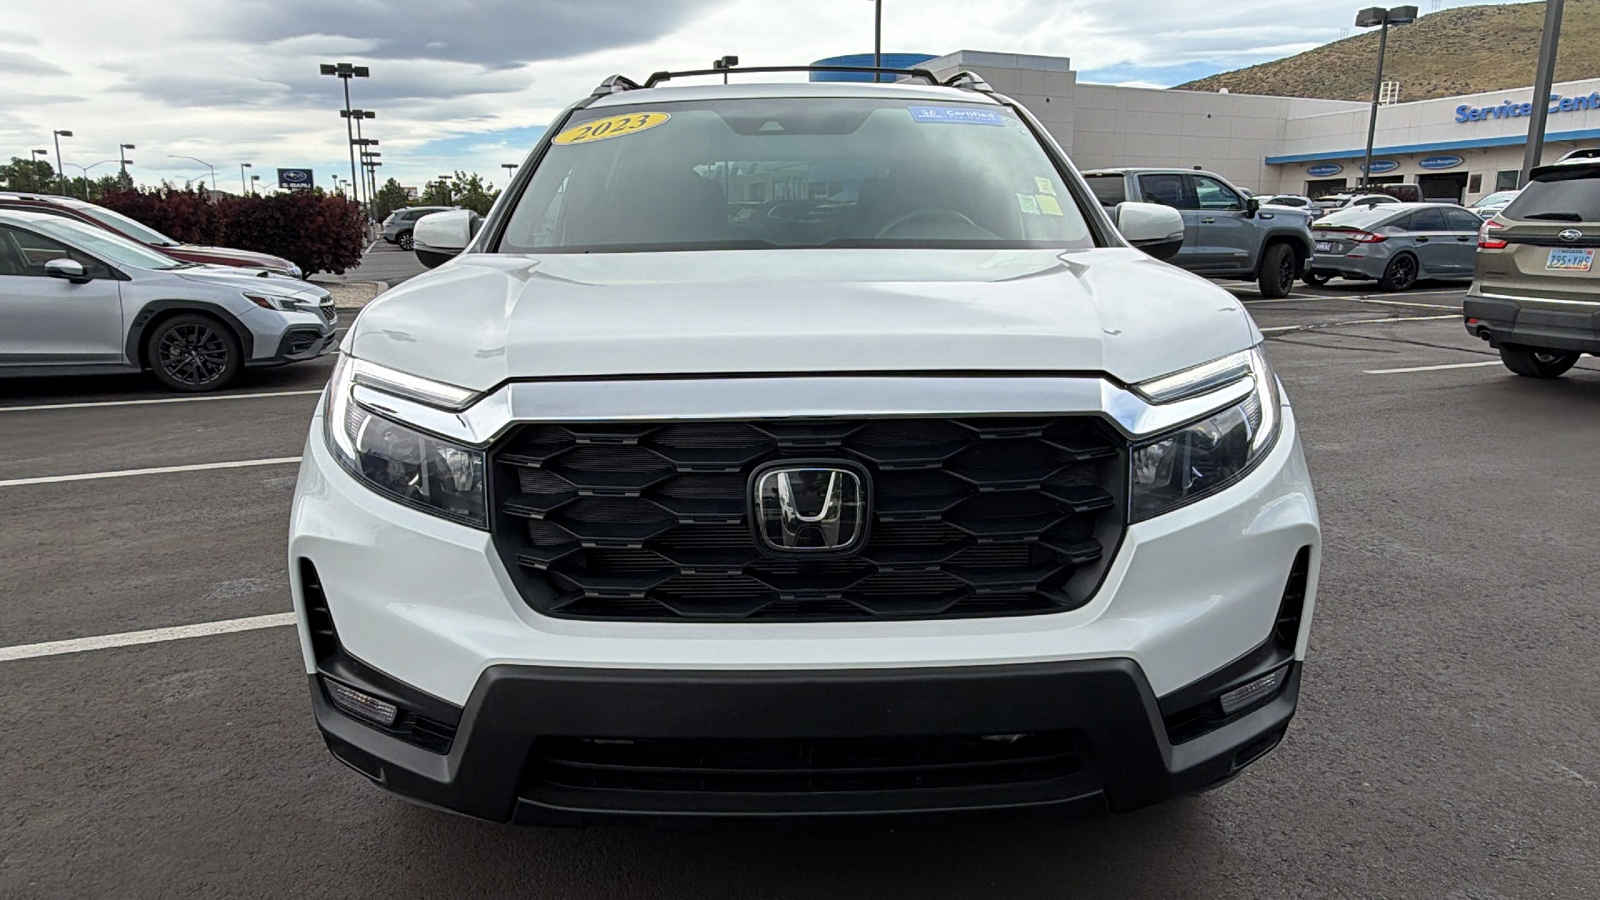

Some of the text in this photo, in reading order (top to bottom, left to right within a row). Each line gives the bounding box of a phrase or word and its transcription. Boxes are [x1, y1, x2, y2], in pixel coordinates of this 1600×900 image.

[946, 110, 994, 118] Certified
[1455, 91, 1600, 123] Service Cent
[570, 115, 651, 142] 2023
[1550, 255, 1590, 266] 795 YHS
